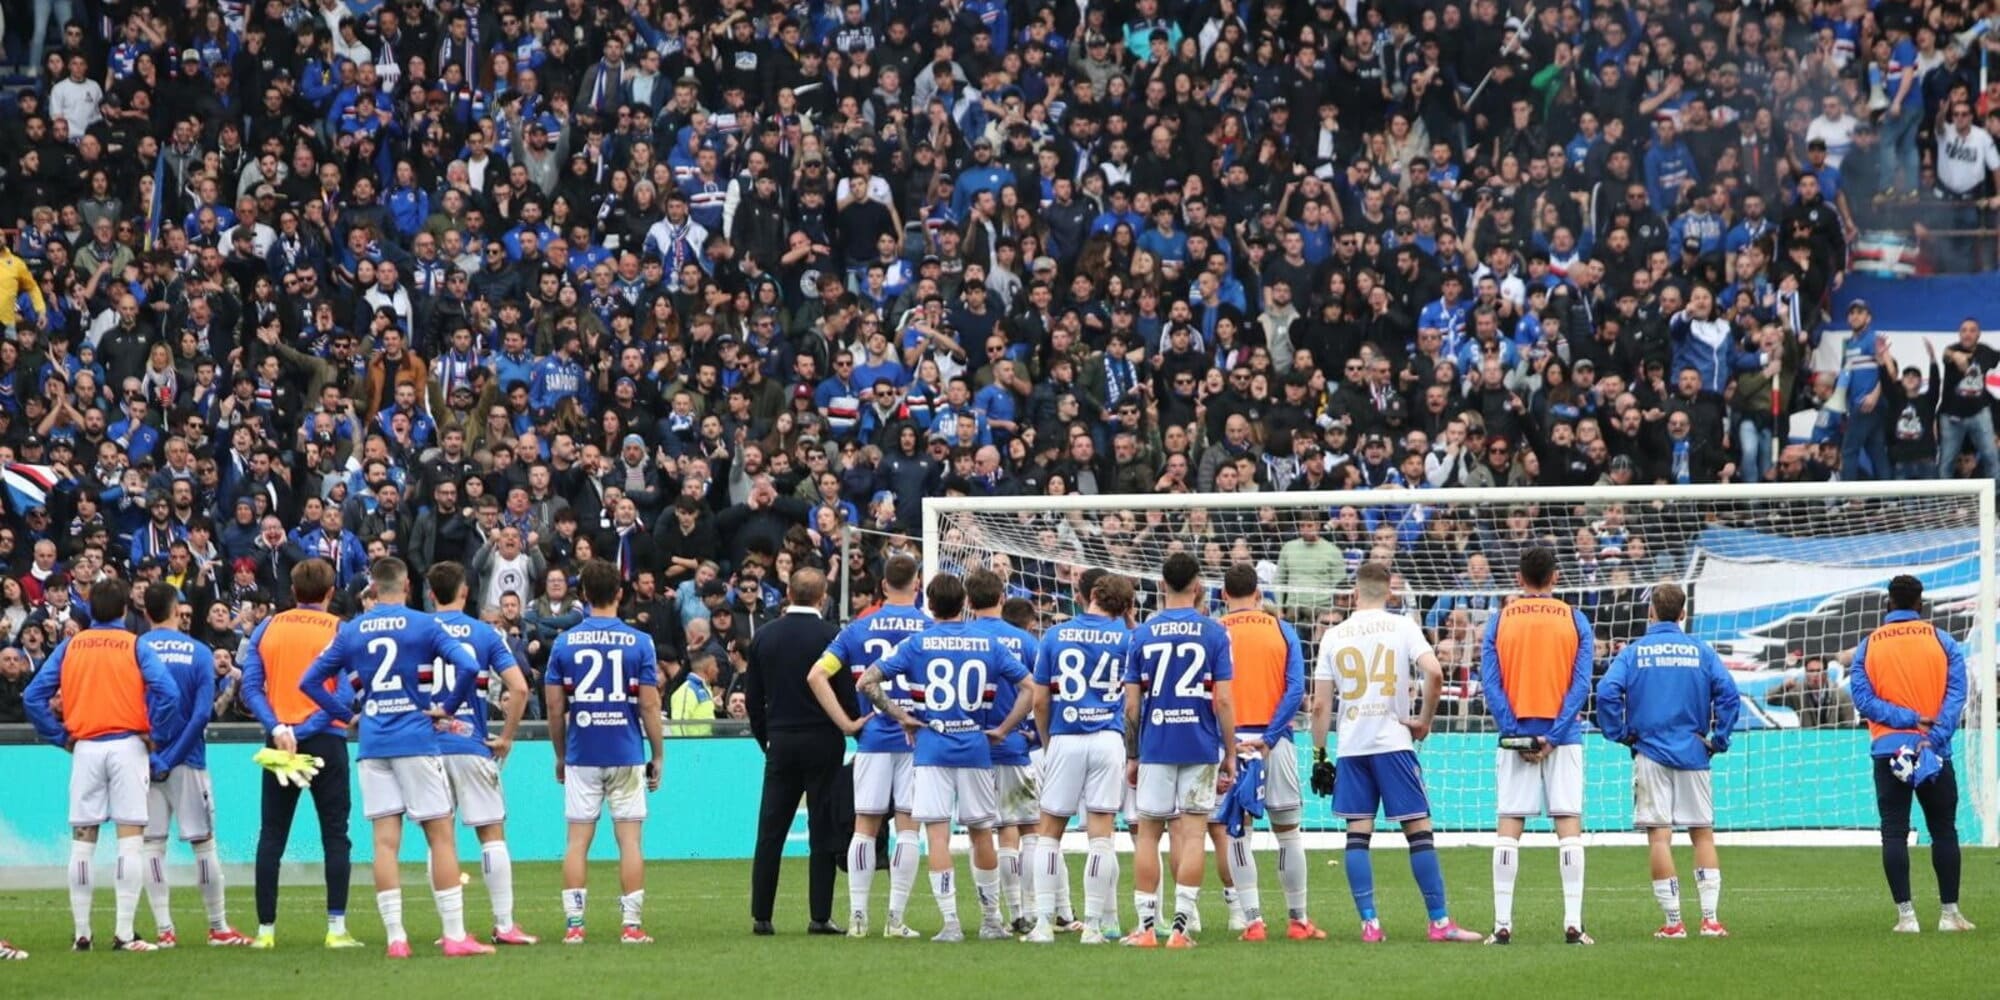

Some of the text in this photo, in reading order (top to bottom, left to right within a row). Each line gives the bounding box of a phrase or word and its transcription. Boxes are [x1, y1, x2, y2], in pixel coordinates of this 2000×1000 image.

[1505, 602, 1568, 618] macron
[274, 614, 333, 630] macron
[359, 616, 407, 633] CURTO
[868, 616, 925, 632] ALTARE
[1150, 622, 1203, 637] VEROLI
[567, 630, 636, 647] BERUATTO
[1058, 628, 1123, 646] SEKULOV
[1871, 623, 1934, 643] macron
[148, 640, 195, 652] cron
[922, 636, 990, 652] BENEDETTI
[1637, 643, 1699, 657] macron
[367, 636, 403, 692] 2
[1142, 641, 1207, 698] 72
[1335, 642, 1397, 700] 94
[573, 649, 627, 703] 21
[1057, 647, 1126, 702] 84
[925, 657, 987, 712] 80
